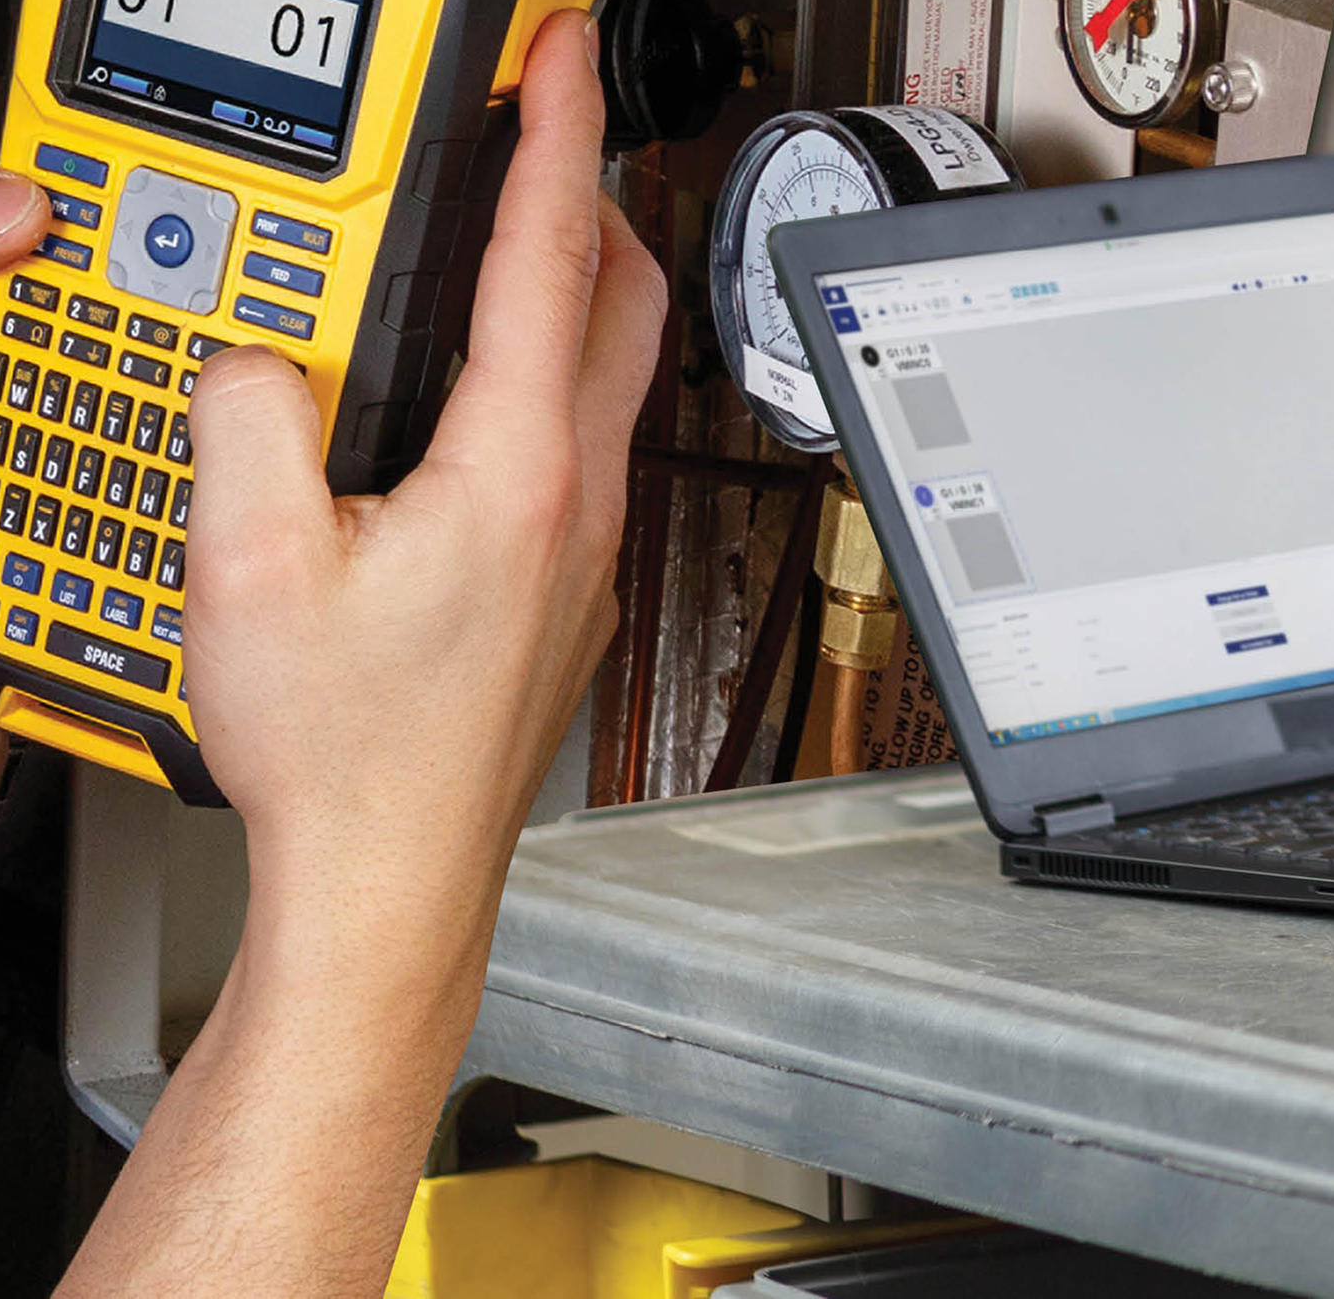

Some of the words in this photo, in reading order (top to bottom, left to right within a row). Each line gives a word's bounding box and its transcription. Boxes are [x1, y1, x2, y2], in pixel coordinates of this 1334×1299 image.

[270, 4, 335, 68] 01
[15, 283, 22, 299] 1
[71, 302, 81, 319] 2
[5, 317, 15, 334] 6
[131, 321, 140, 337] 3
[65, 338, 75, 354] 7
[192, 340, 202, 356] 4
[123, 356, 133, 374] 8
[11, 384, 28, 405] W
[42, 395, 55, 415] E
[73, 406, 87, 426] R
[108, 417, 119, 435] T
[140, 428, 152, 447] Y
[171, 438, 185, 457] U
[15, 450, 26, 469] S
[46, 460, 58, 480] D
[78, 471, 89, 490] F
[110, 483, 122, 502] G
[141, 493, 155, 513] H
[3, 509, 14, 529] Z
[176, 505, 187, 523] J
[33, 521, 45, 540] X
[66, 531, 77, 550] C
[99, 543, 110, 561] V
[129, 554, 141, 572] B
[161, 564, 175, 584] N
[58, 590, 77, 606] LIST
[105, 606, 130, 627] LABEL
[7, 623, 28, 641] FONT
[84, 644, 125, 673] SPACE
[903, 657, 920, 683] TO
